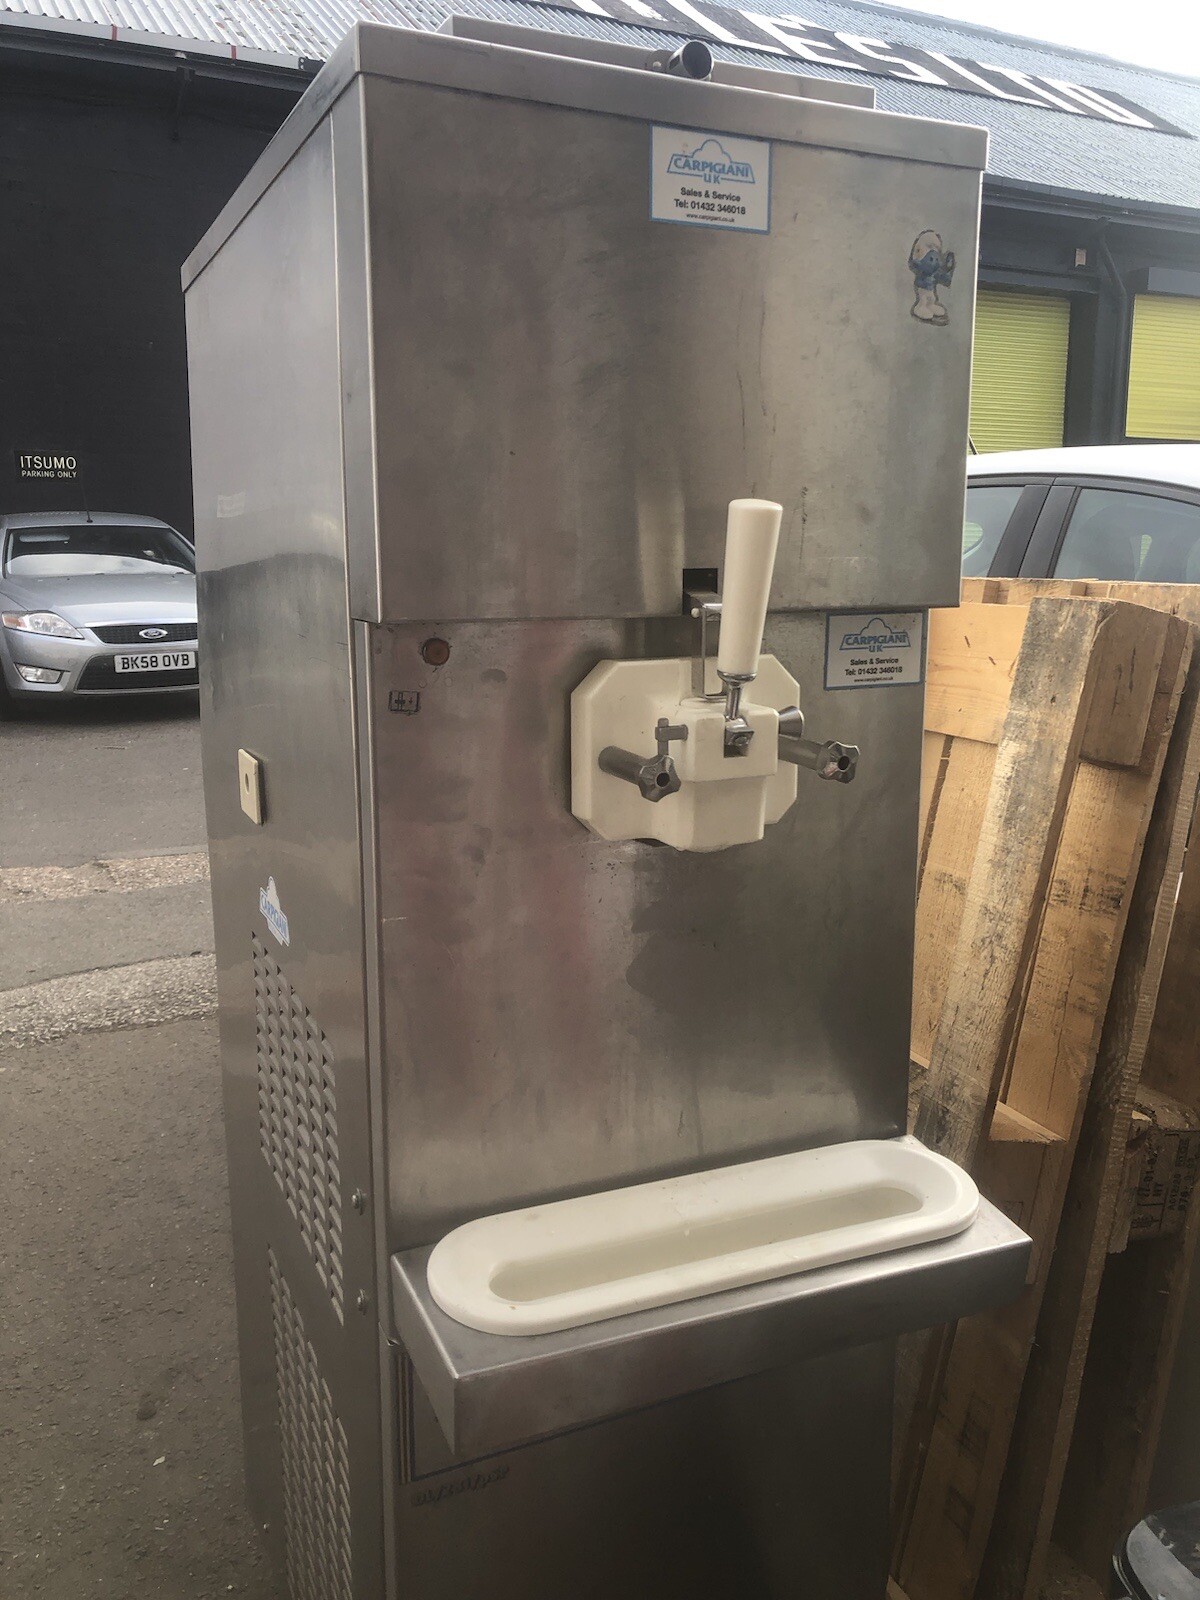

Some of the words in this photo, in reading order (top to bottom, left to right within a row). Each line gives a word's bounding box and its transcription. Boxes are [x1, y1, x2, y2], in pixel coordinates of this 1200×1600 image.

[921, 49, 1156, 128] LTD
[673, 157, 750, 178] CARPIGIANI
[703, 172, 721, 185] UK
[680, 186, 703, 198] Sales
[704, 190, 710, 199] &
[712, 190, 741, 202] Service
[674, 198, 689, 209] Tel:
[690, 200, 716, 212] 01432
[717, 203, 746, 215] 346018
[20, 455, 77, 470] ITSUMO
[21, 470, 55, 478] PARKING
[57, 470, 77, 478] ONLY
[845, 634, 907, 646] CARPIGIANI
[868, 645, 883, 653] UK
[121, 656, 158, 670] BK58
[162, 653, 190, 667] OVB
[875, 657, 899, 665] Service
[845, 668, 856, 676] Tel:
[857, 667, 878, 675] 01432
[879, 665, 903, 674] 346018
